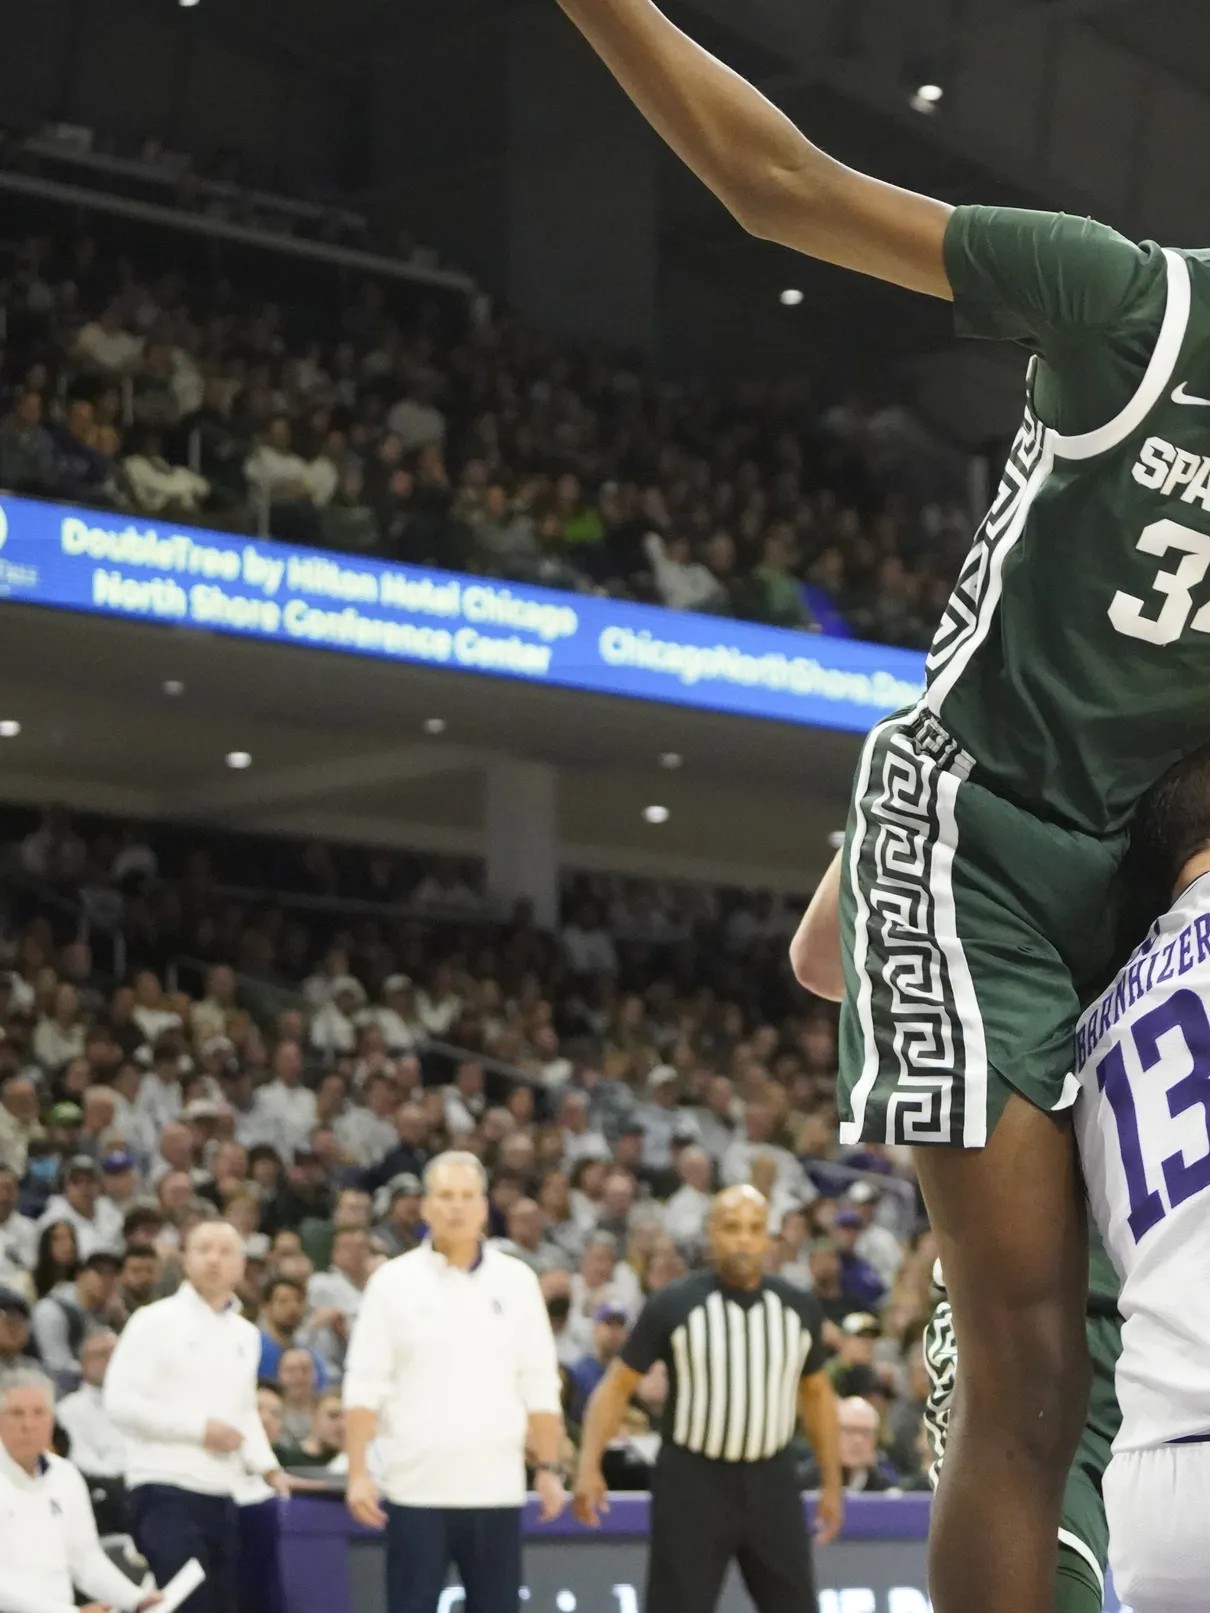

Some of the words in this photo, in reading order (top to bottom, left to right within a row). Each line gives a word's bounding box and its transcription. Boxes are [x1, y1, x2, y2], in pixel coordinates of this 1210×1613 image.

[61, 517, 241, 581] DoubleTree
[243, 545, 285, 595] by
[287, 555, 378, 602] Hilton
[380, 571, 461, 618] Hotel
[463, 585, 579, 641] Chicago
[93, 568, 187, 618] North
[189, 583, 281, 632] Shore
[283, 600, 452, 662] Conference
[453, 627, 552, 675] Center
